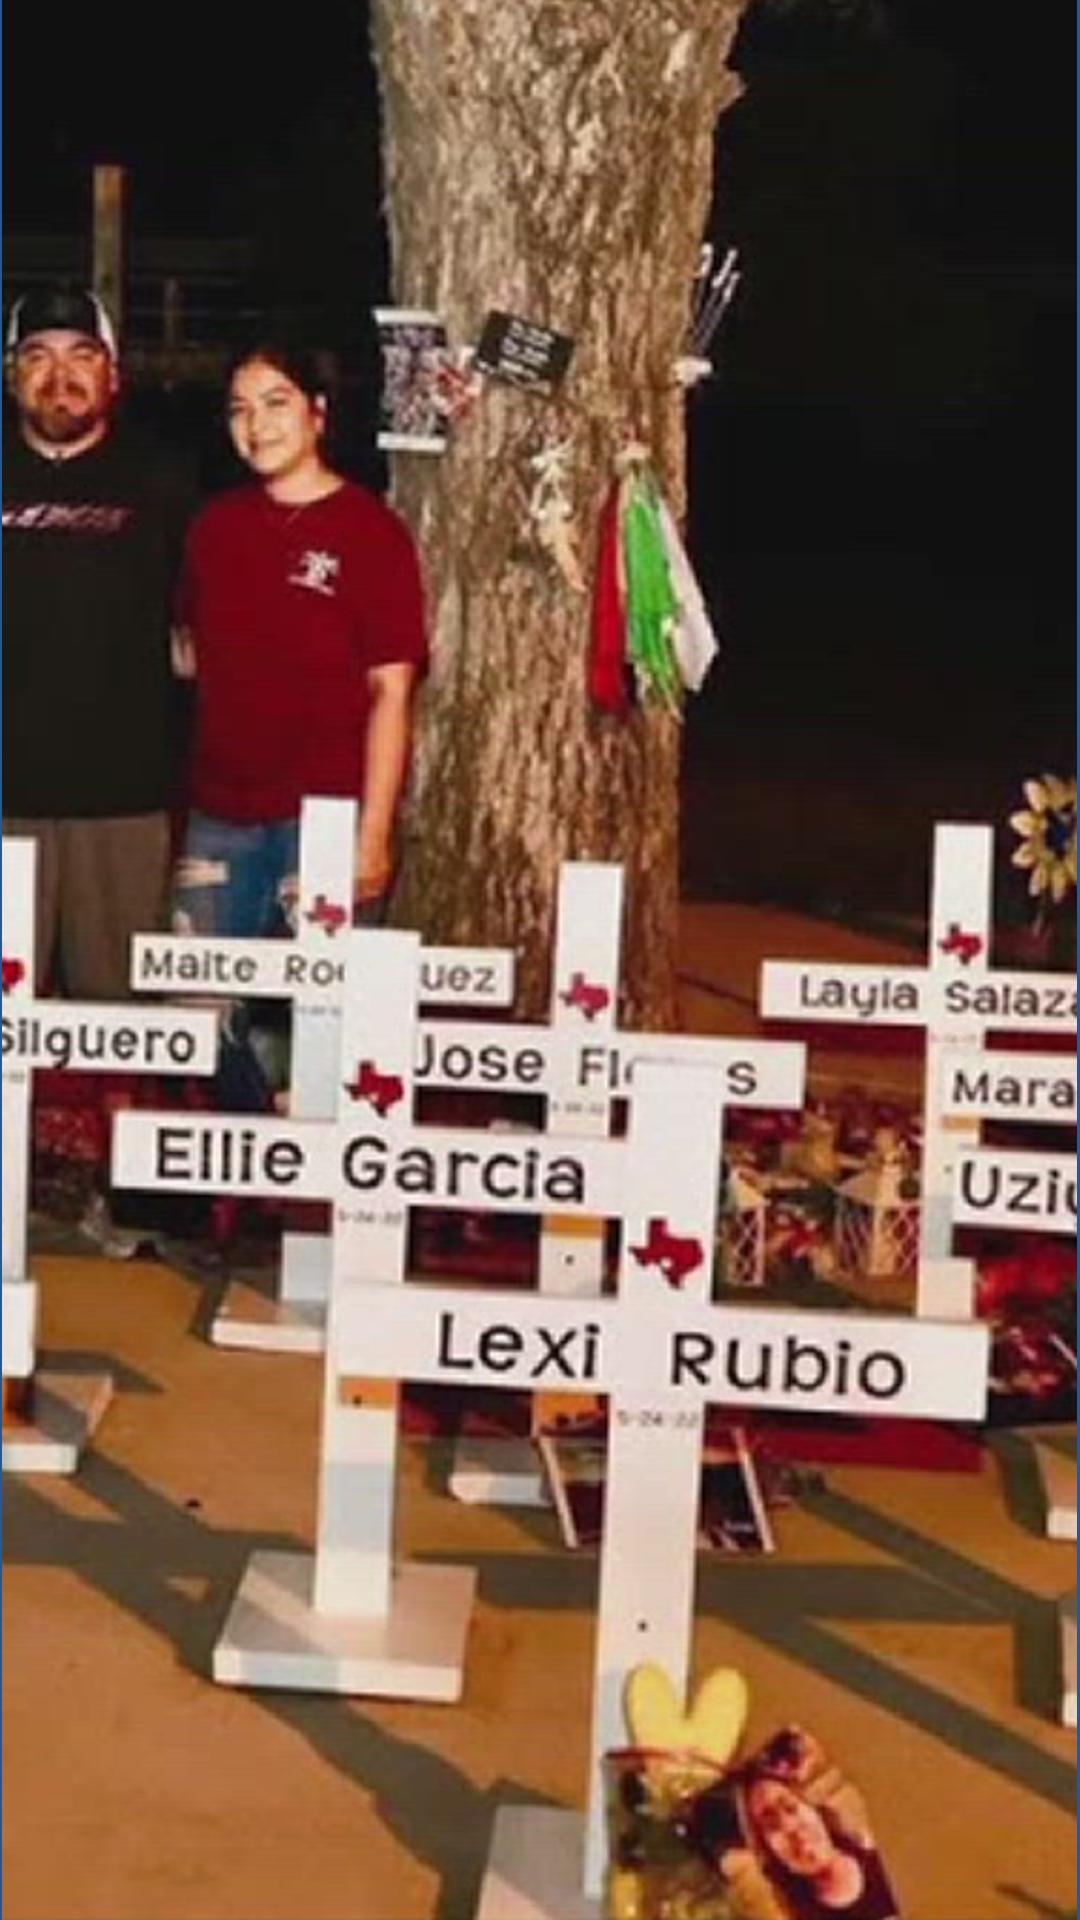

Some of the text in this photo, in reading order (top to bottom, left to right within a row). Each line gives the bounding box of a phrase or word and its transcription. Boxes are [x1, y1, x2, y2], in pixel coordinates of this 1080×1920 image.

[141, 949, 257, 982] Maite
[800, 974, 918, 1017] Layla
[413, 1034, 545, 1083] Jose
[953, 1069, 1075, 1108] Mara
[157, 1127, 584, 1203] Ellie Garcia
[439, 1312, 904, 1398] Lexi Rubio
